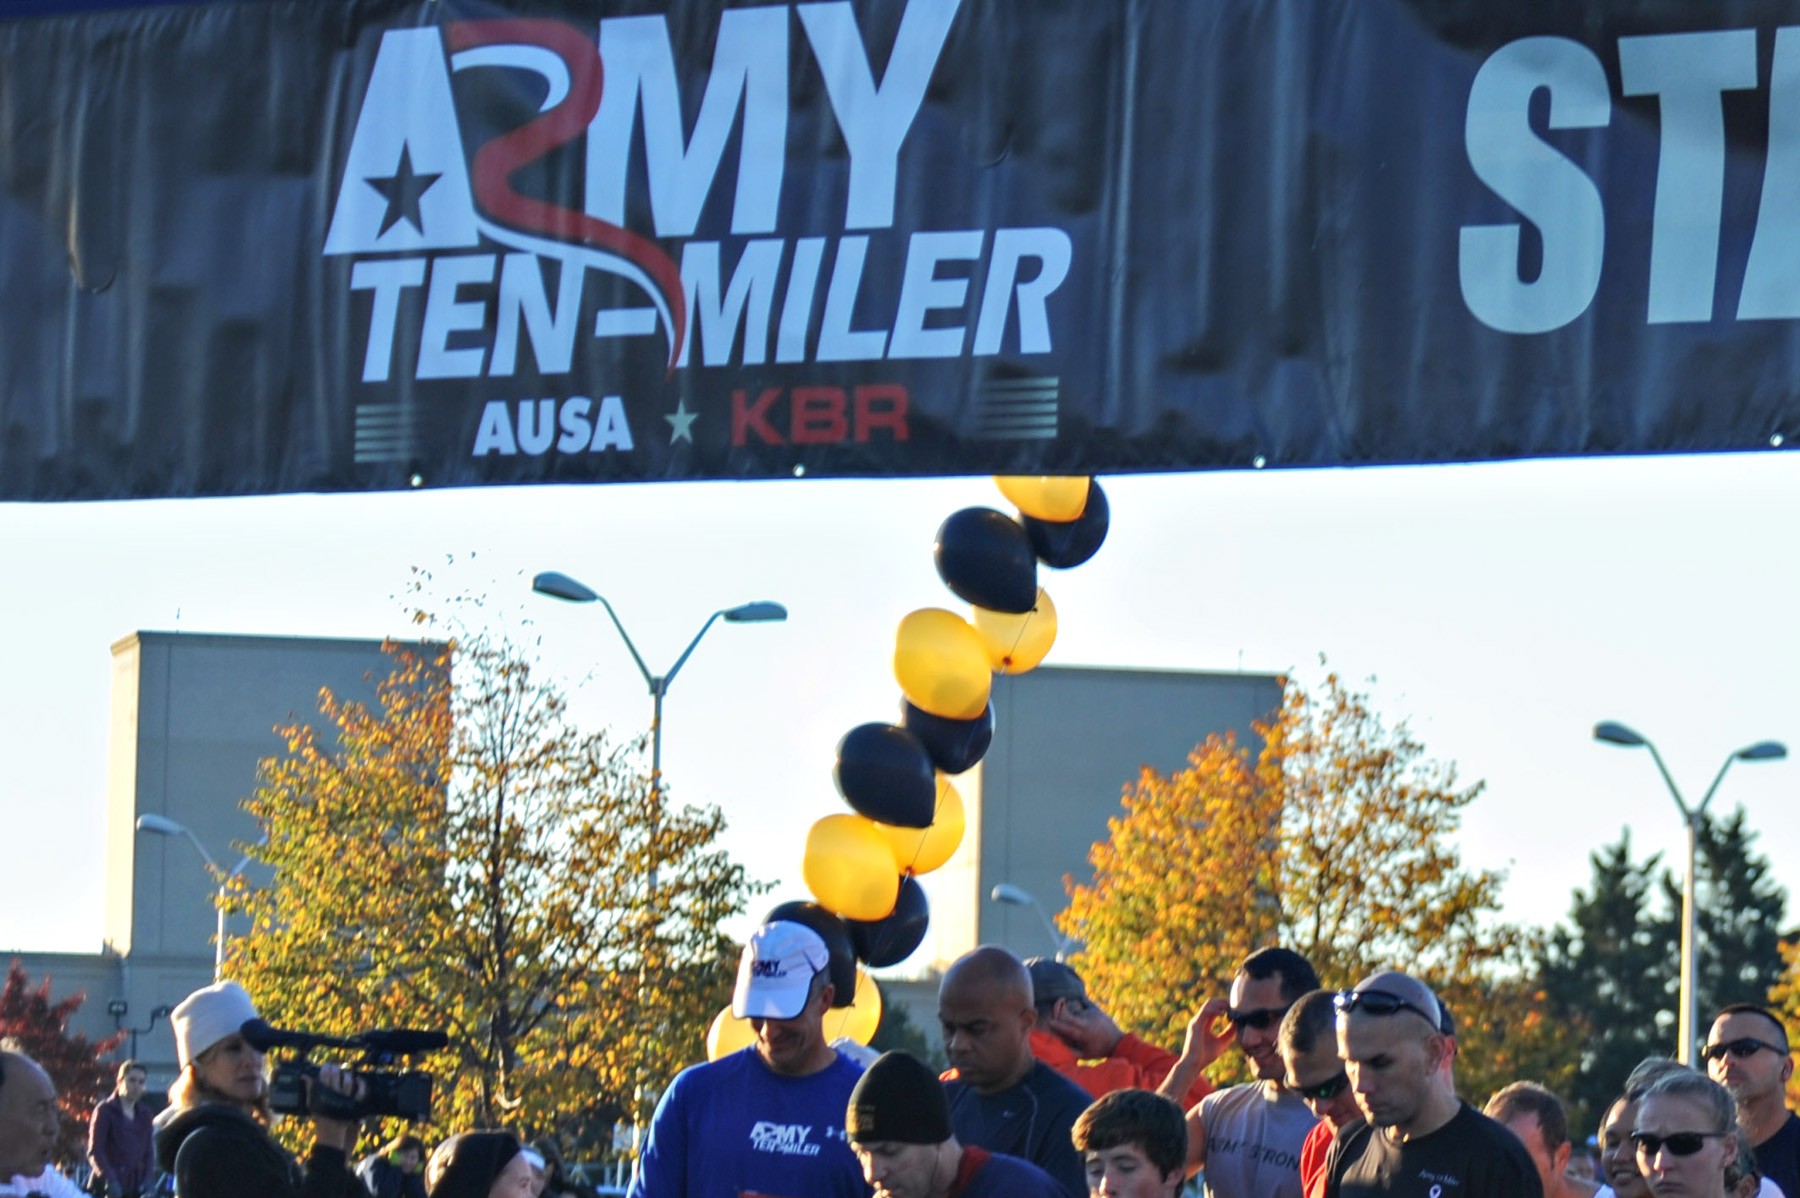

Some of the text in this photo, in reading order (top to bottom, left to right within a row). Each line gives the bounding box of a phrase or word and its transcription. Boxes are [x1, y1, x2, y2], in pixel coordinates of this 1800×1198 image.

[323, 0, 962, 256] ARMY
[350, 227, 1073, 384] TEN-MILER
[473, 385, 910, 457] AUSA KBR
[749, 1120, 812, 1145] ARMY
